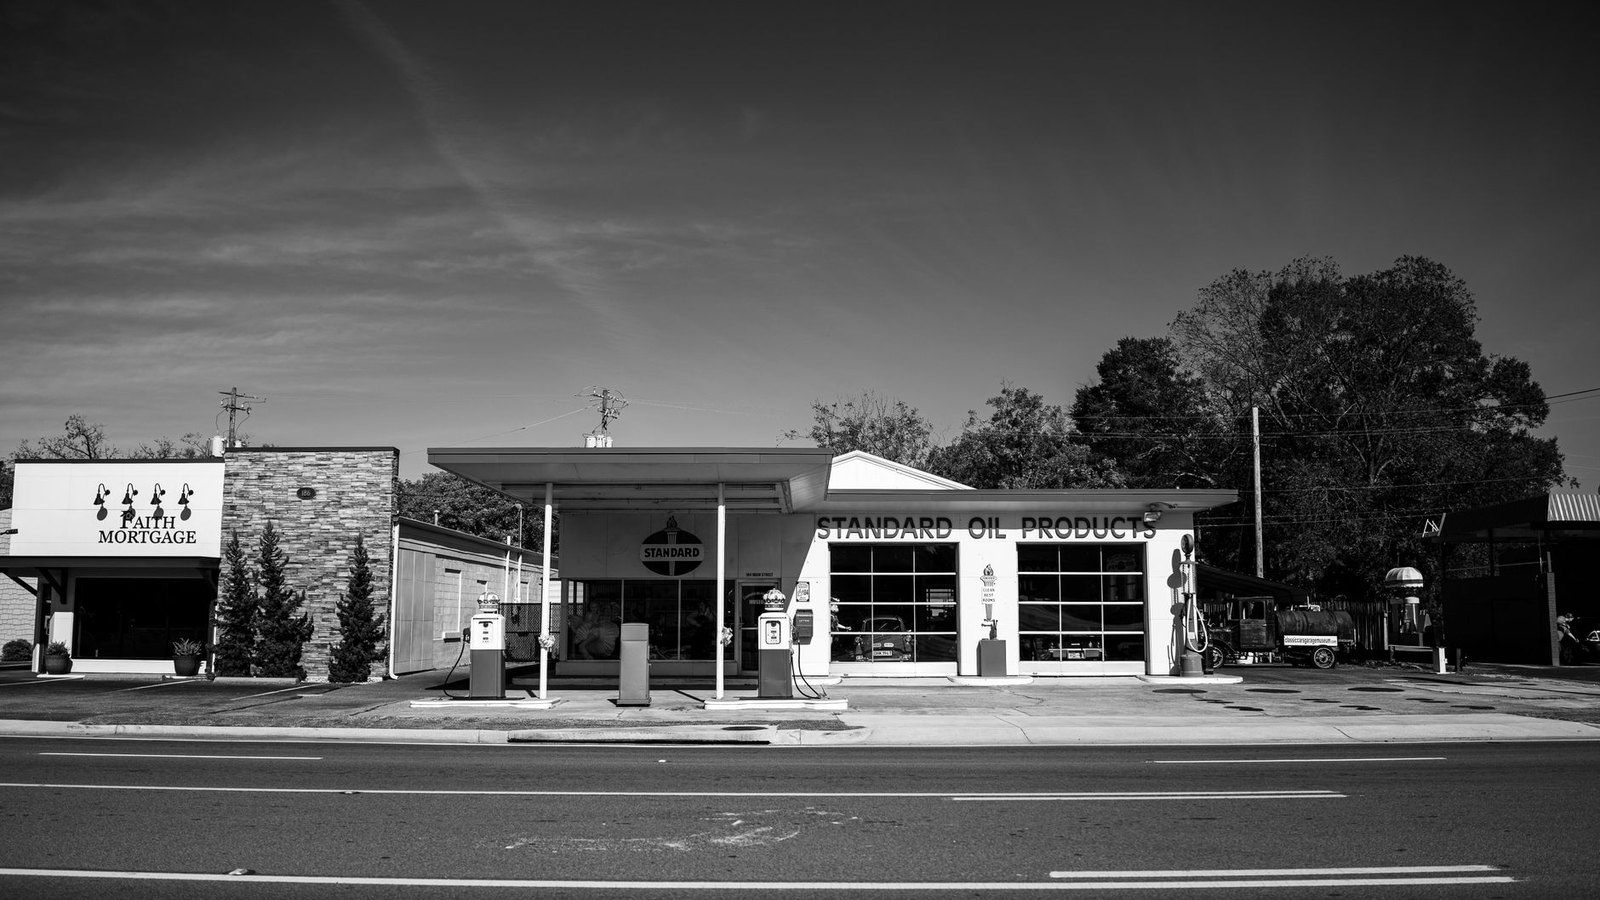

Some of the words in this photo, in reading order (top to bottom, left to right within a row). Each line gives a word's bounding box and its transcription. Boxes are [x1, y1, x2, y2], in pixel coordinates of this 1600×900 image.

[120, 511, 176, 529] FAITH
[817, 517, 953, 539] STANDARD
[968, 517, 1007, 539] OIL
[1022, 517, 1157, 539] PRODUCTS
[98, 530, 197, 544] MORTGAGE
[644, 547, 700, 558] STANDARD
